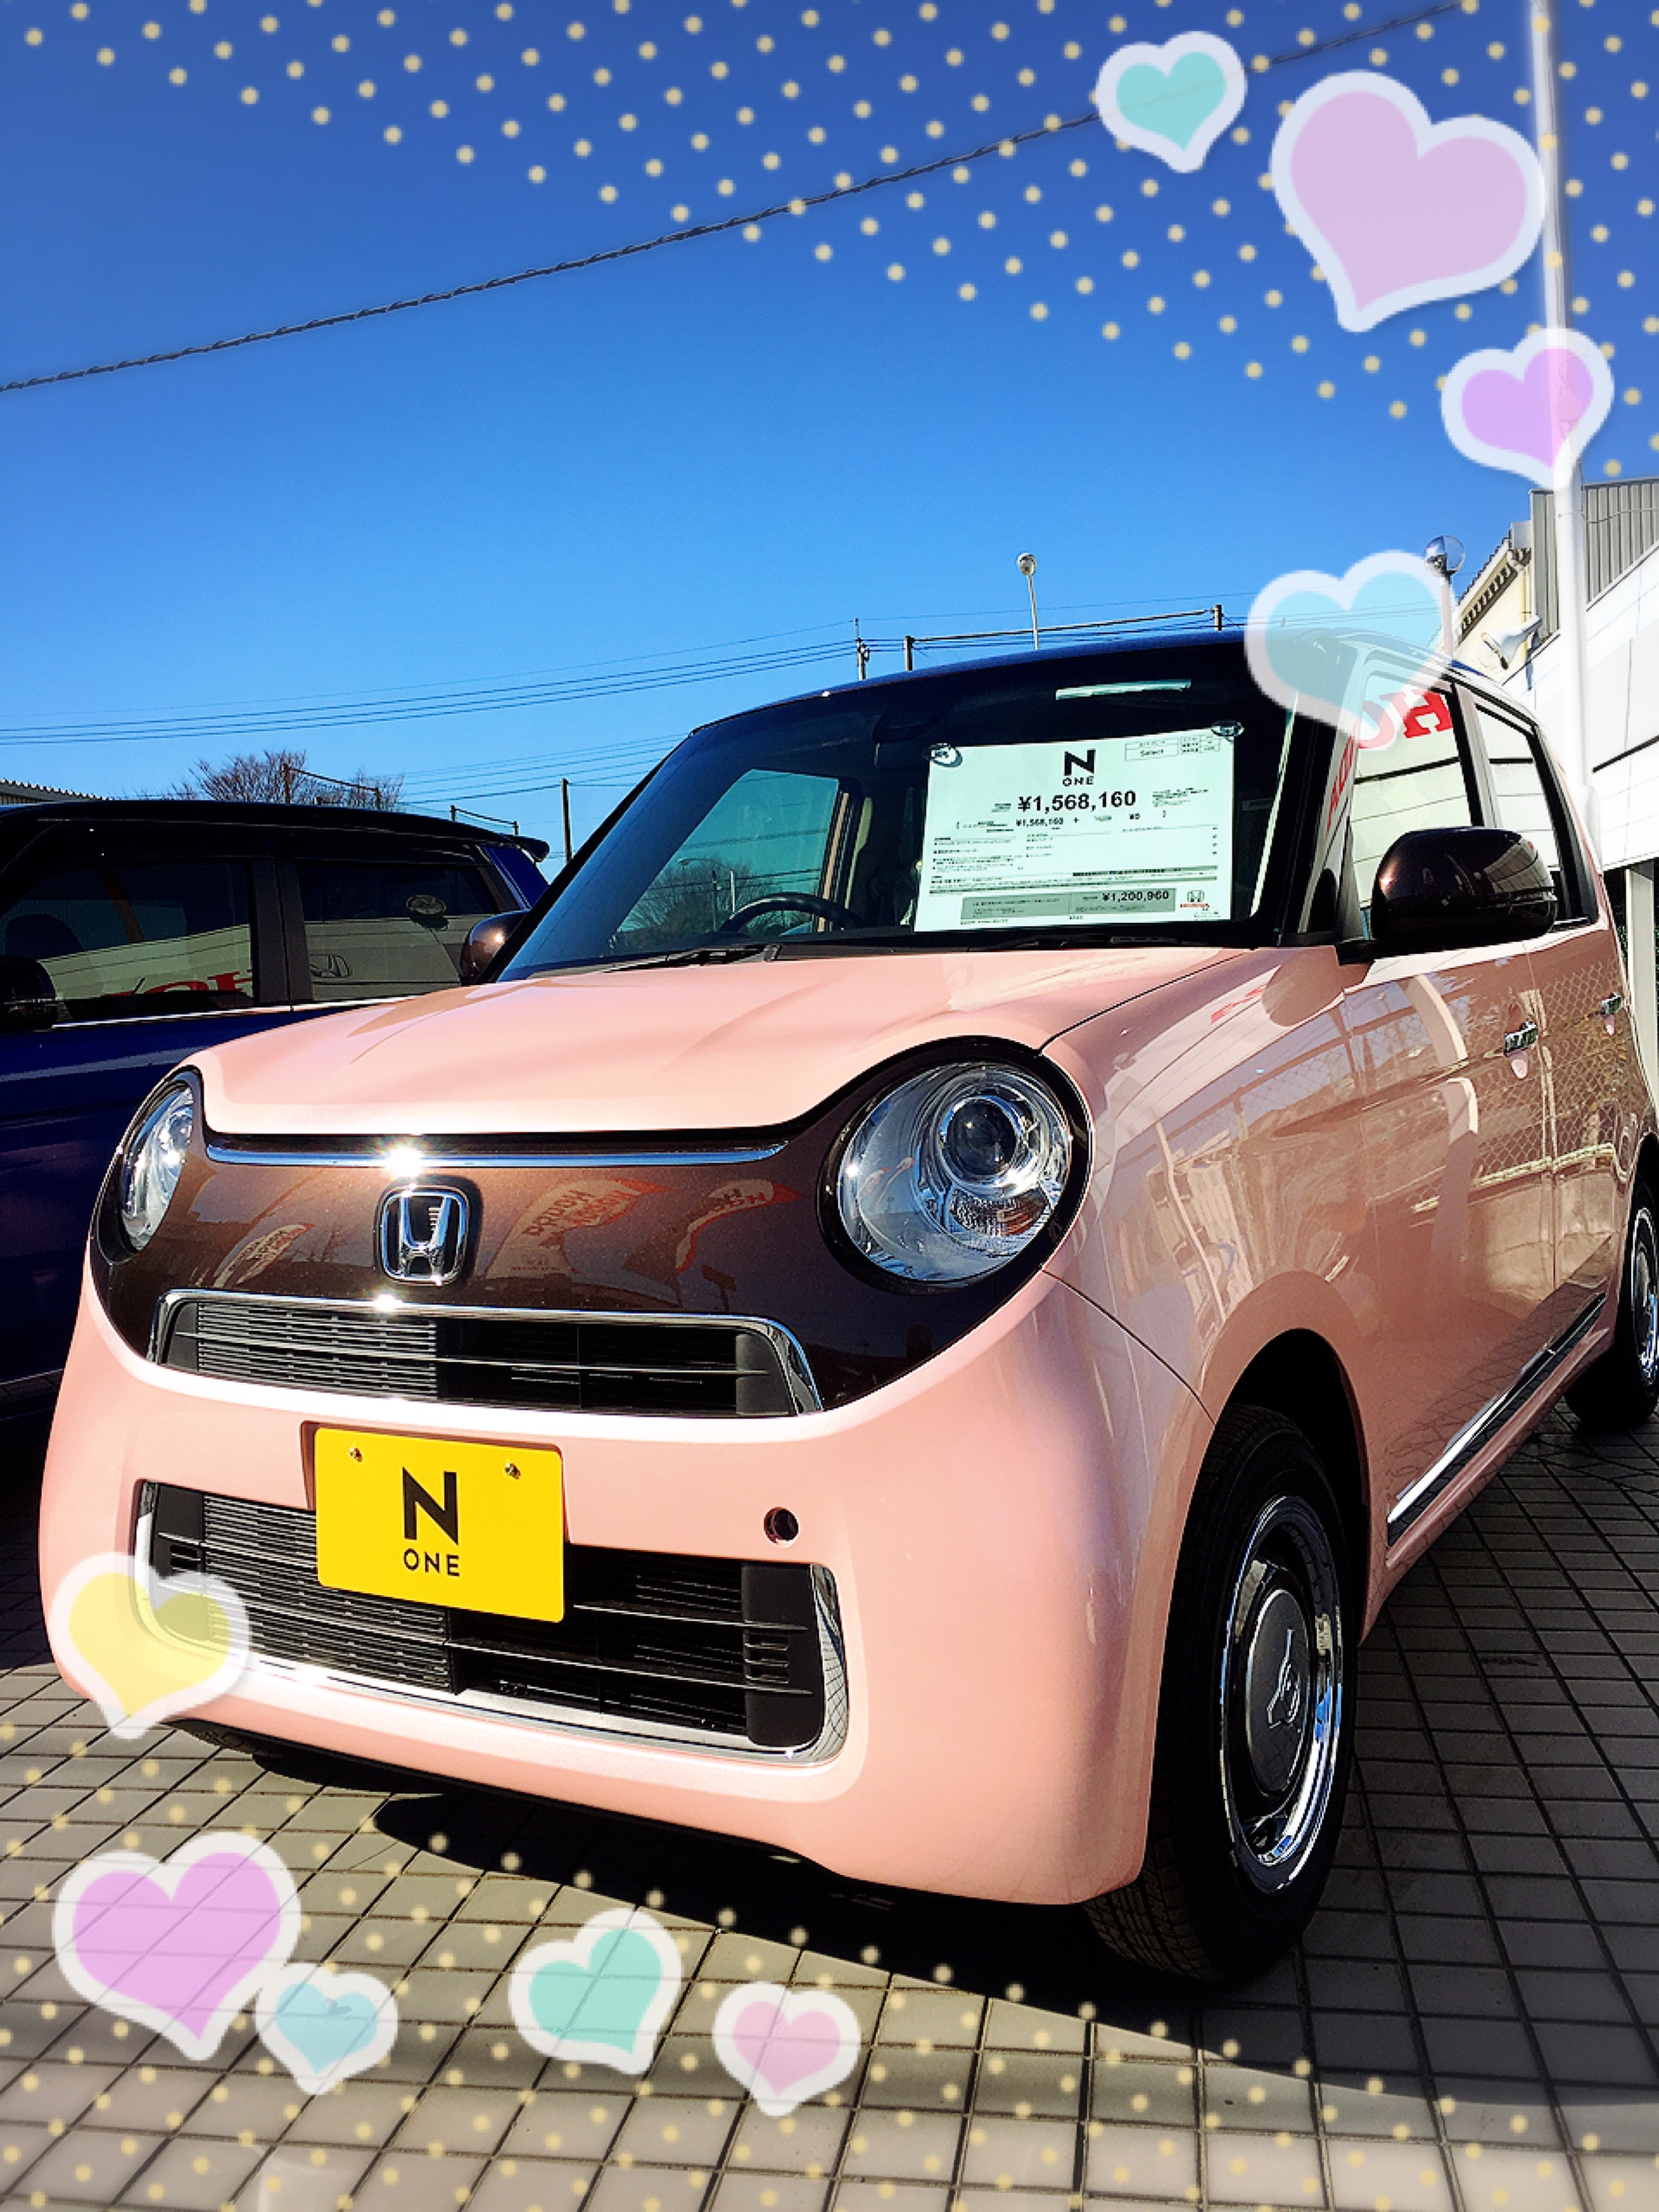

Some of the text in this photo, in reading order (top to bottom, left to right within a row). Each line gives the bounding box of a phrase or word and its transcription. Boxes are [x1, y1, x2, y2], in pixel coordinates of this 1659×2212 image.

[1064, 749, 1096, 776] N
[1062, 775, 1094, 787] ONE
[1017, 790, 1136, 814] ¥1,568,160
[1102, 890, 1170, 903] ¥1,200,960
[402, 1466, 459, 1546] N
[403, 1547, 460, 1577] ONE
